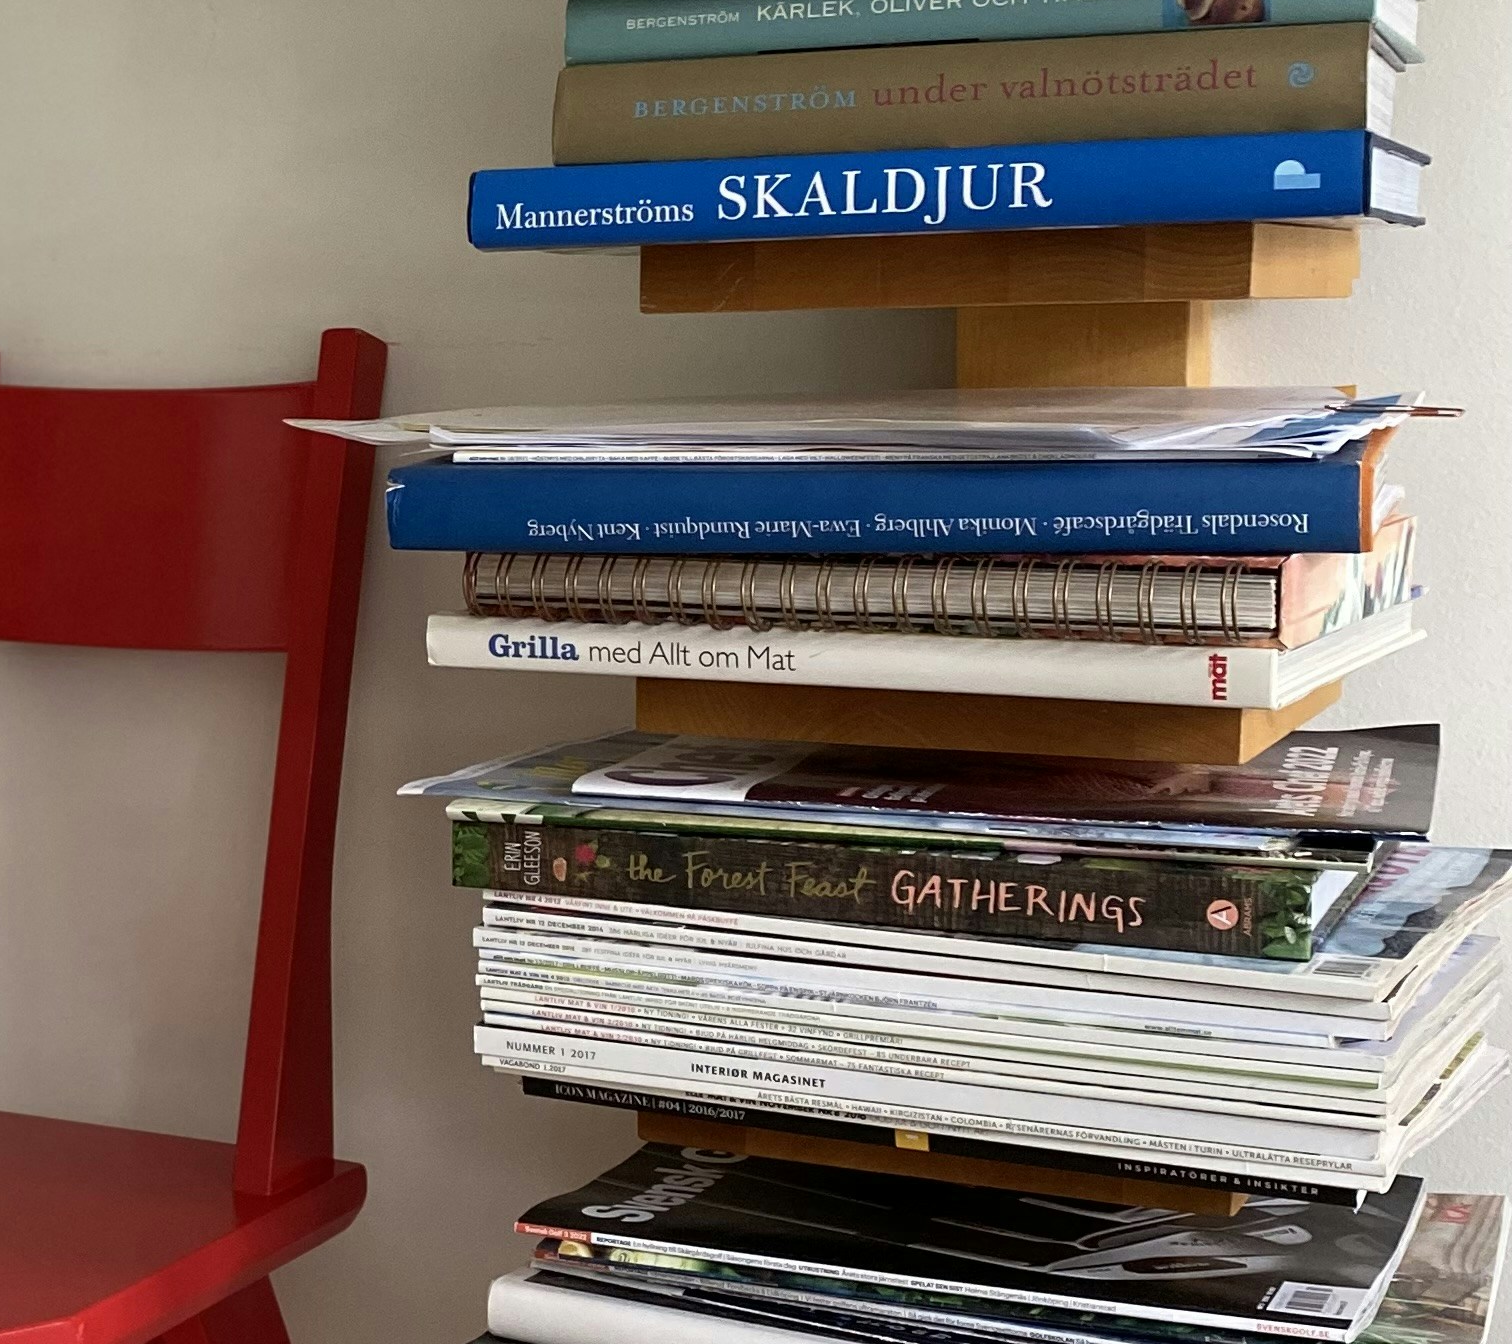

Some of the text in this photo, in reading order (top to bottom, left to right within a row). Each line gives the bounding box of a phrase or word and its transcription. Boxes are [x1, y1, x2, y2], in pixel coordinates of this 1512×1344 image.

[626, 9, 740, 31] BERGENSTRÖM
[633, 59, 1258, 119] BERGENSTRÖM under valnötsträdet
[495, 161, 1052, 231] Mannerströms SKALDJUR
[527, 508, 1309, 540] Rosendals Trädgårdscafé Monika Ahlberg Ewa-Marie Rundquist Kent Nyberg
[488, 632, 797, 672] Grilla med Allt om Mat
[503, 841, 521, 873] ERIN
[524, 830, 542, 885] GLEESON
[626, 851, 1146, 933] the Forest Feast GATHERINGS
[1242, 896, 1254, 937] ABRAMS
[535, 996, 563, 1006] LANTLIV
[567, 999, 584, 1008] MAT
[593, 1002, 607, 1010] VIN
[698, 1014, 727, 1026] VÅRENS
[730, 1018, 748, 1028] ALLA
[750, 1021, 779, 1031] FESTER
[799, 1026, 834, 1037] VINFYND
[500, 1058, 540, 1070] VAGABOND
[506, 1041, 555, 1056] NUMMER
[571, 1049, 596, 1060] 2017
[691, 1063, 826, 1088] INTERIØR MAGASINET
[555, 1083, 583, 1097] ICON
[587, 1087, 651, 1106] MAGAZINE
[658, 1100, 680, 1111] #04
[688, 1106, 746, 1120] 2016/2017
[757, 1091, 783, 1103] ÅRETS
[785, 1095, 810, 1105] BÄSTA
[811, 1098, 844, 1110] RESMÅL
[889, 1109, 942, 1122] KIRGIZISTAN
[950, 1116, 997, 1128] COLOMBIA
[1076, 1129, 1140, 1146] FÖRVANDLING
[1149, 1139, 1186, 1151] MÅSTEN
[1194, 1145, 1223, 1156] TURIN
[1231, 1148, 1291, 1163] ULTRALÄTTA
[1293, 1157, 1352, 1171] RESEPRYLAR
[582, 1164, 724, 1223] Svensk
[1118, 1162, 1227, 1182] INSPIRATÖRER
[1247, 1179, 1318, 1195] INSIKTER
